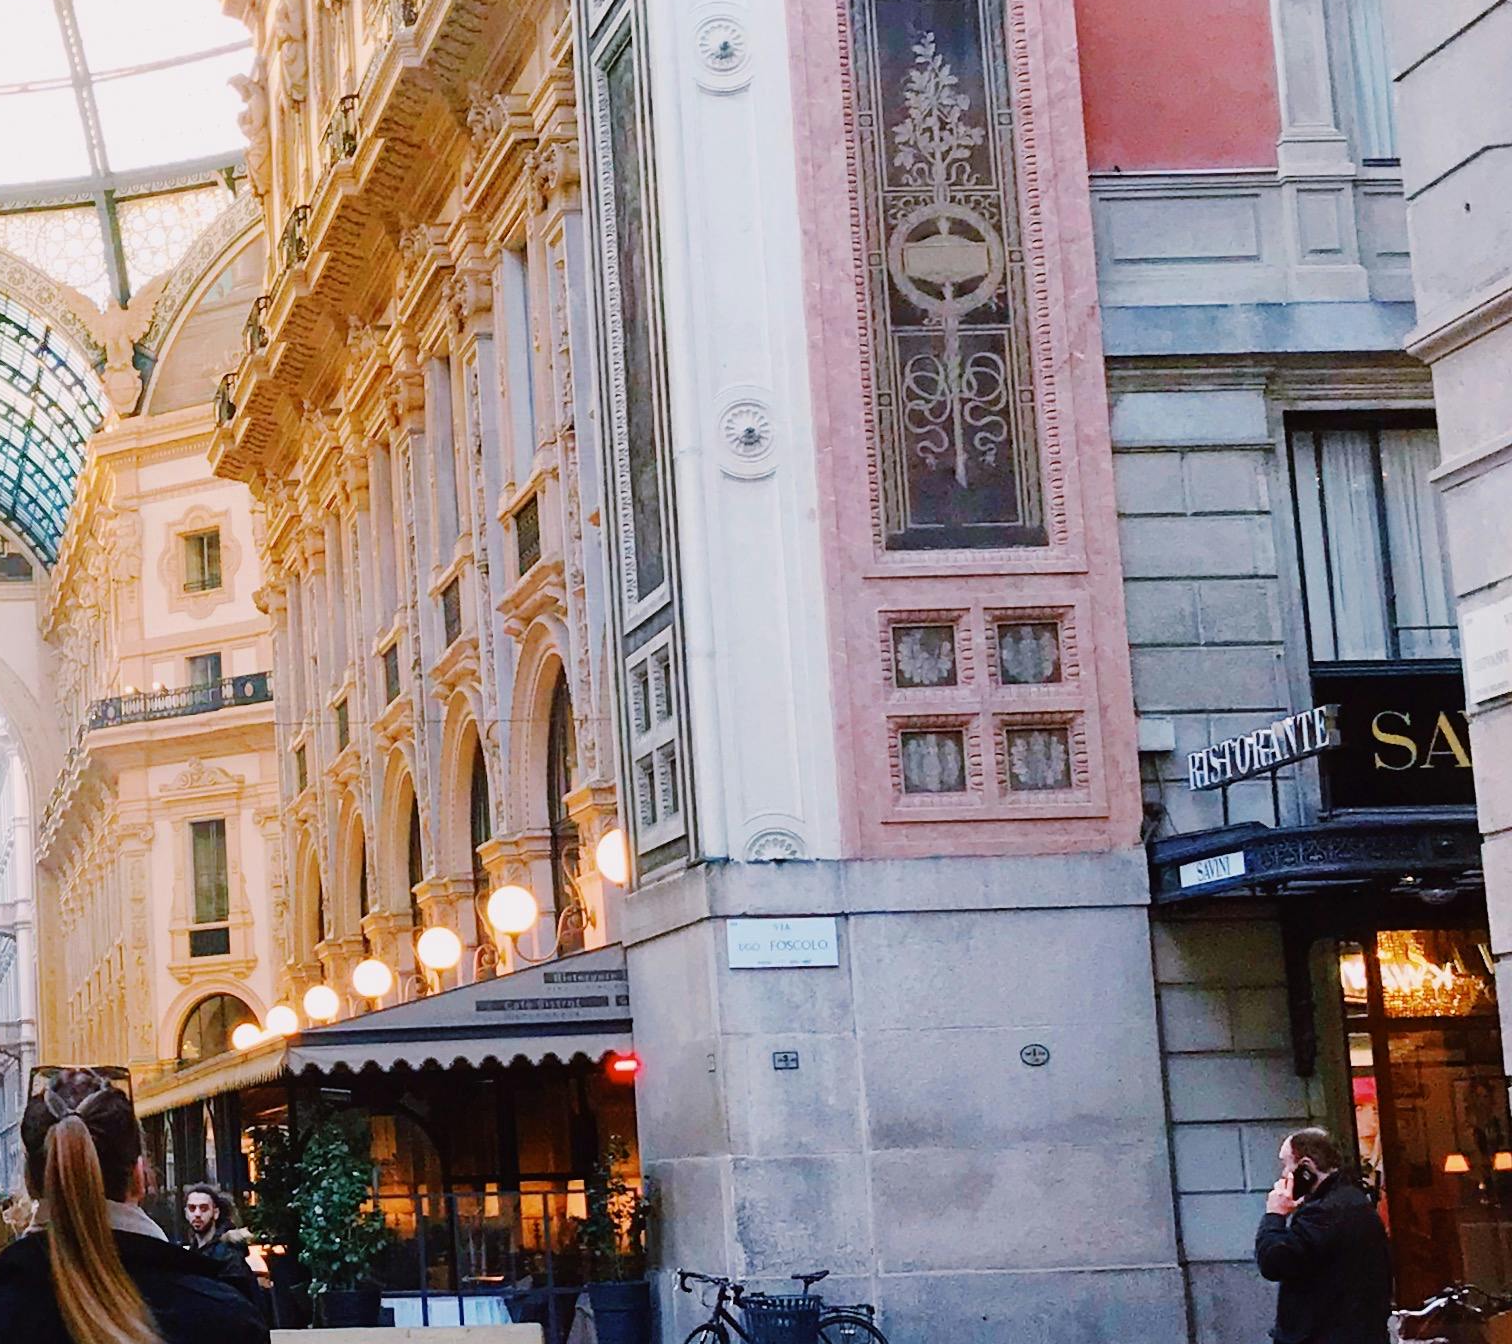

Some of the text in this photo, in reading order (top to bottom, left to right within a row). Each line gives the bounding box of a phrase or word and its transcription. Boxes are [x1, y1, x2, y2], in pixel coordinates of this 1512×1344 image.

[1188, 707, 1330, 790] RISTORANTE
[1371, 710, 1473, 770] SA
[774, 923, 791, 931] VIA
[738, 939, 828, 952] UGO FOSCOLO
